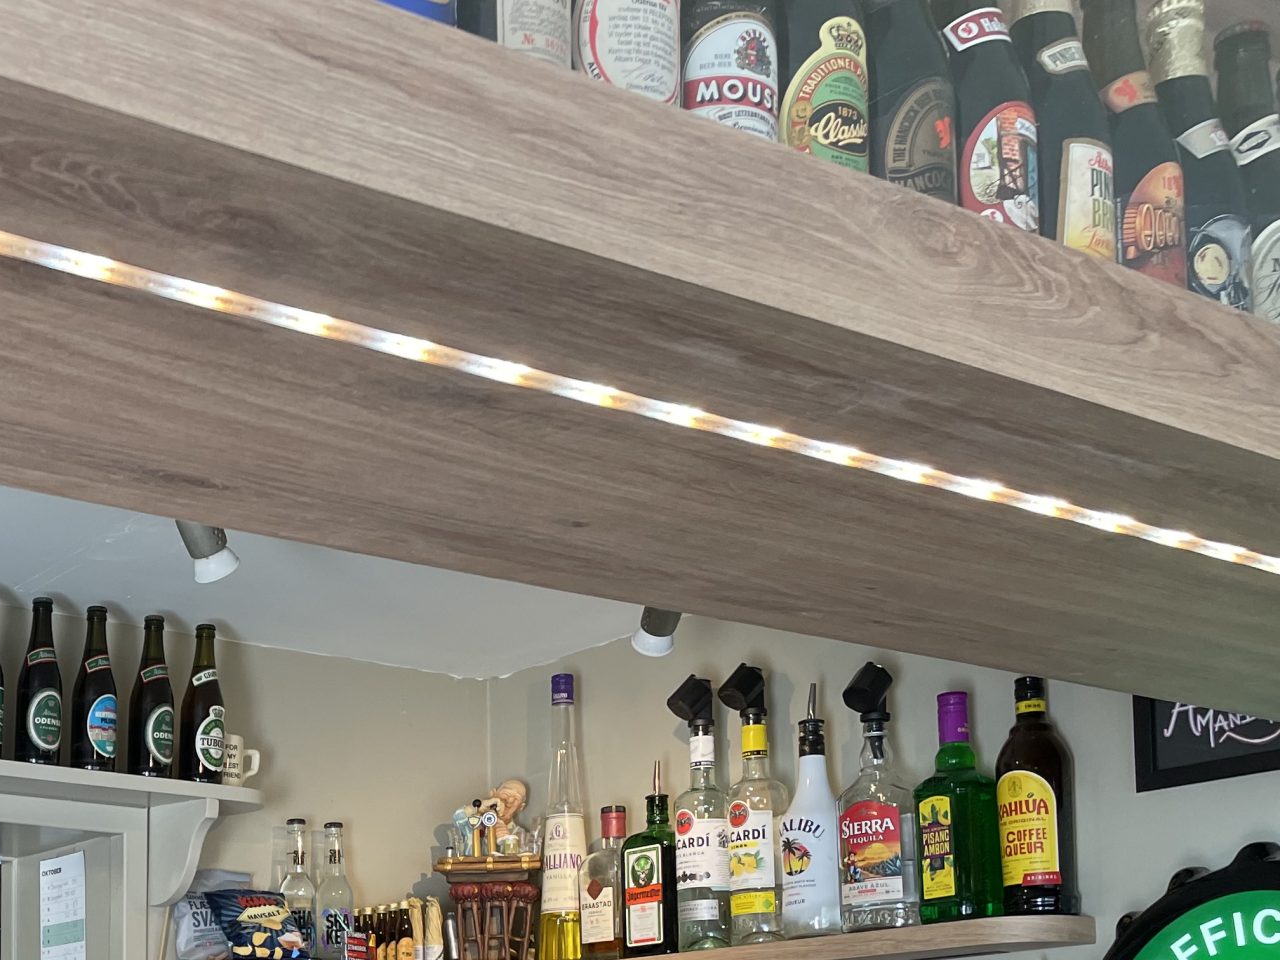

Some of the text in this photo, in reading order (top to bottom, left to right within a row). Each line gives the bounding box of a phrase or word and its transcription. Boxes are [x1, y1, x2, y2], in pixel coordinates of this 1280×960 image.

[799, 57, 855, 99] TRADITIONEL
[838, 106, 858, 120] 1873
[841, 817, 894, 839] SIERRA
[1006, 827, 1048, 844] COFFEE
[850, 835, 884, 845] TEQUILA
[923, 829, 950, 846] PISANG
[924, 841, 950, 857] AMBON
[42, 867, 62, 877] OKTOBER
[582, 900, 612, 911] BRAASTAD
[247, 910, 281, 920] HAVSALT
[326, 913, 350, 930] SHA
